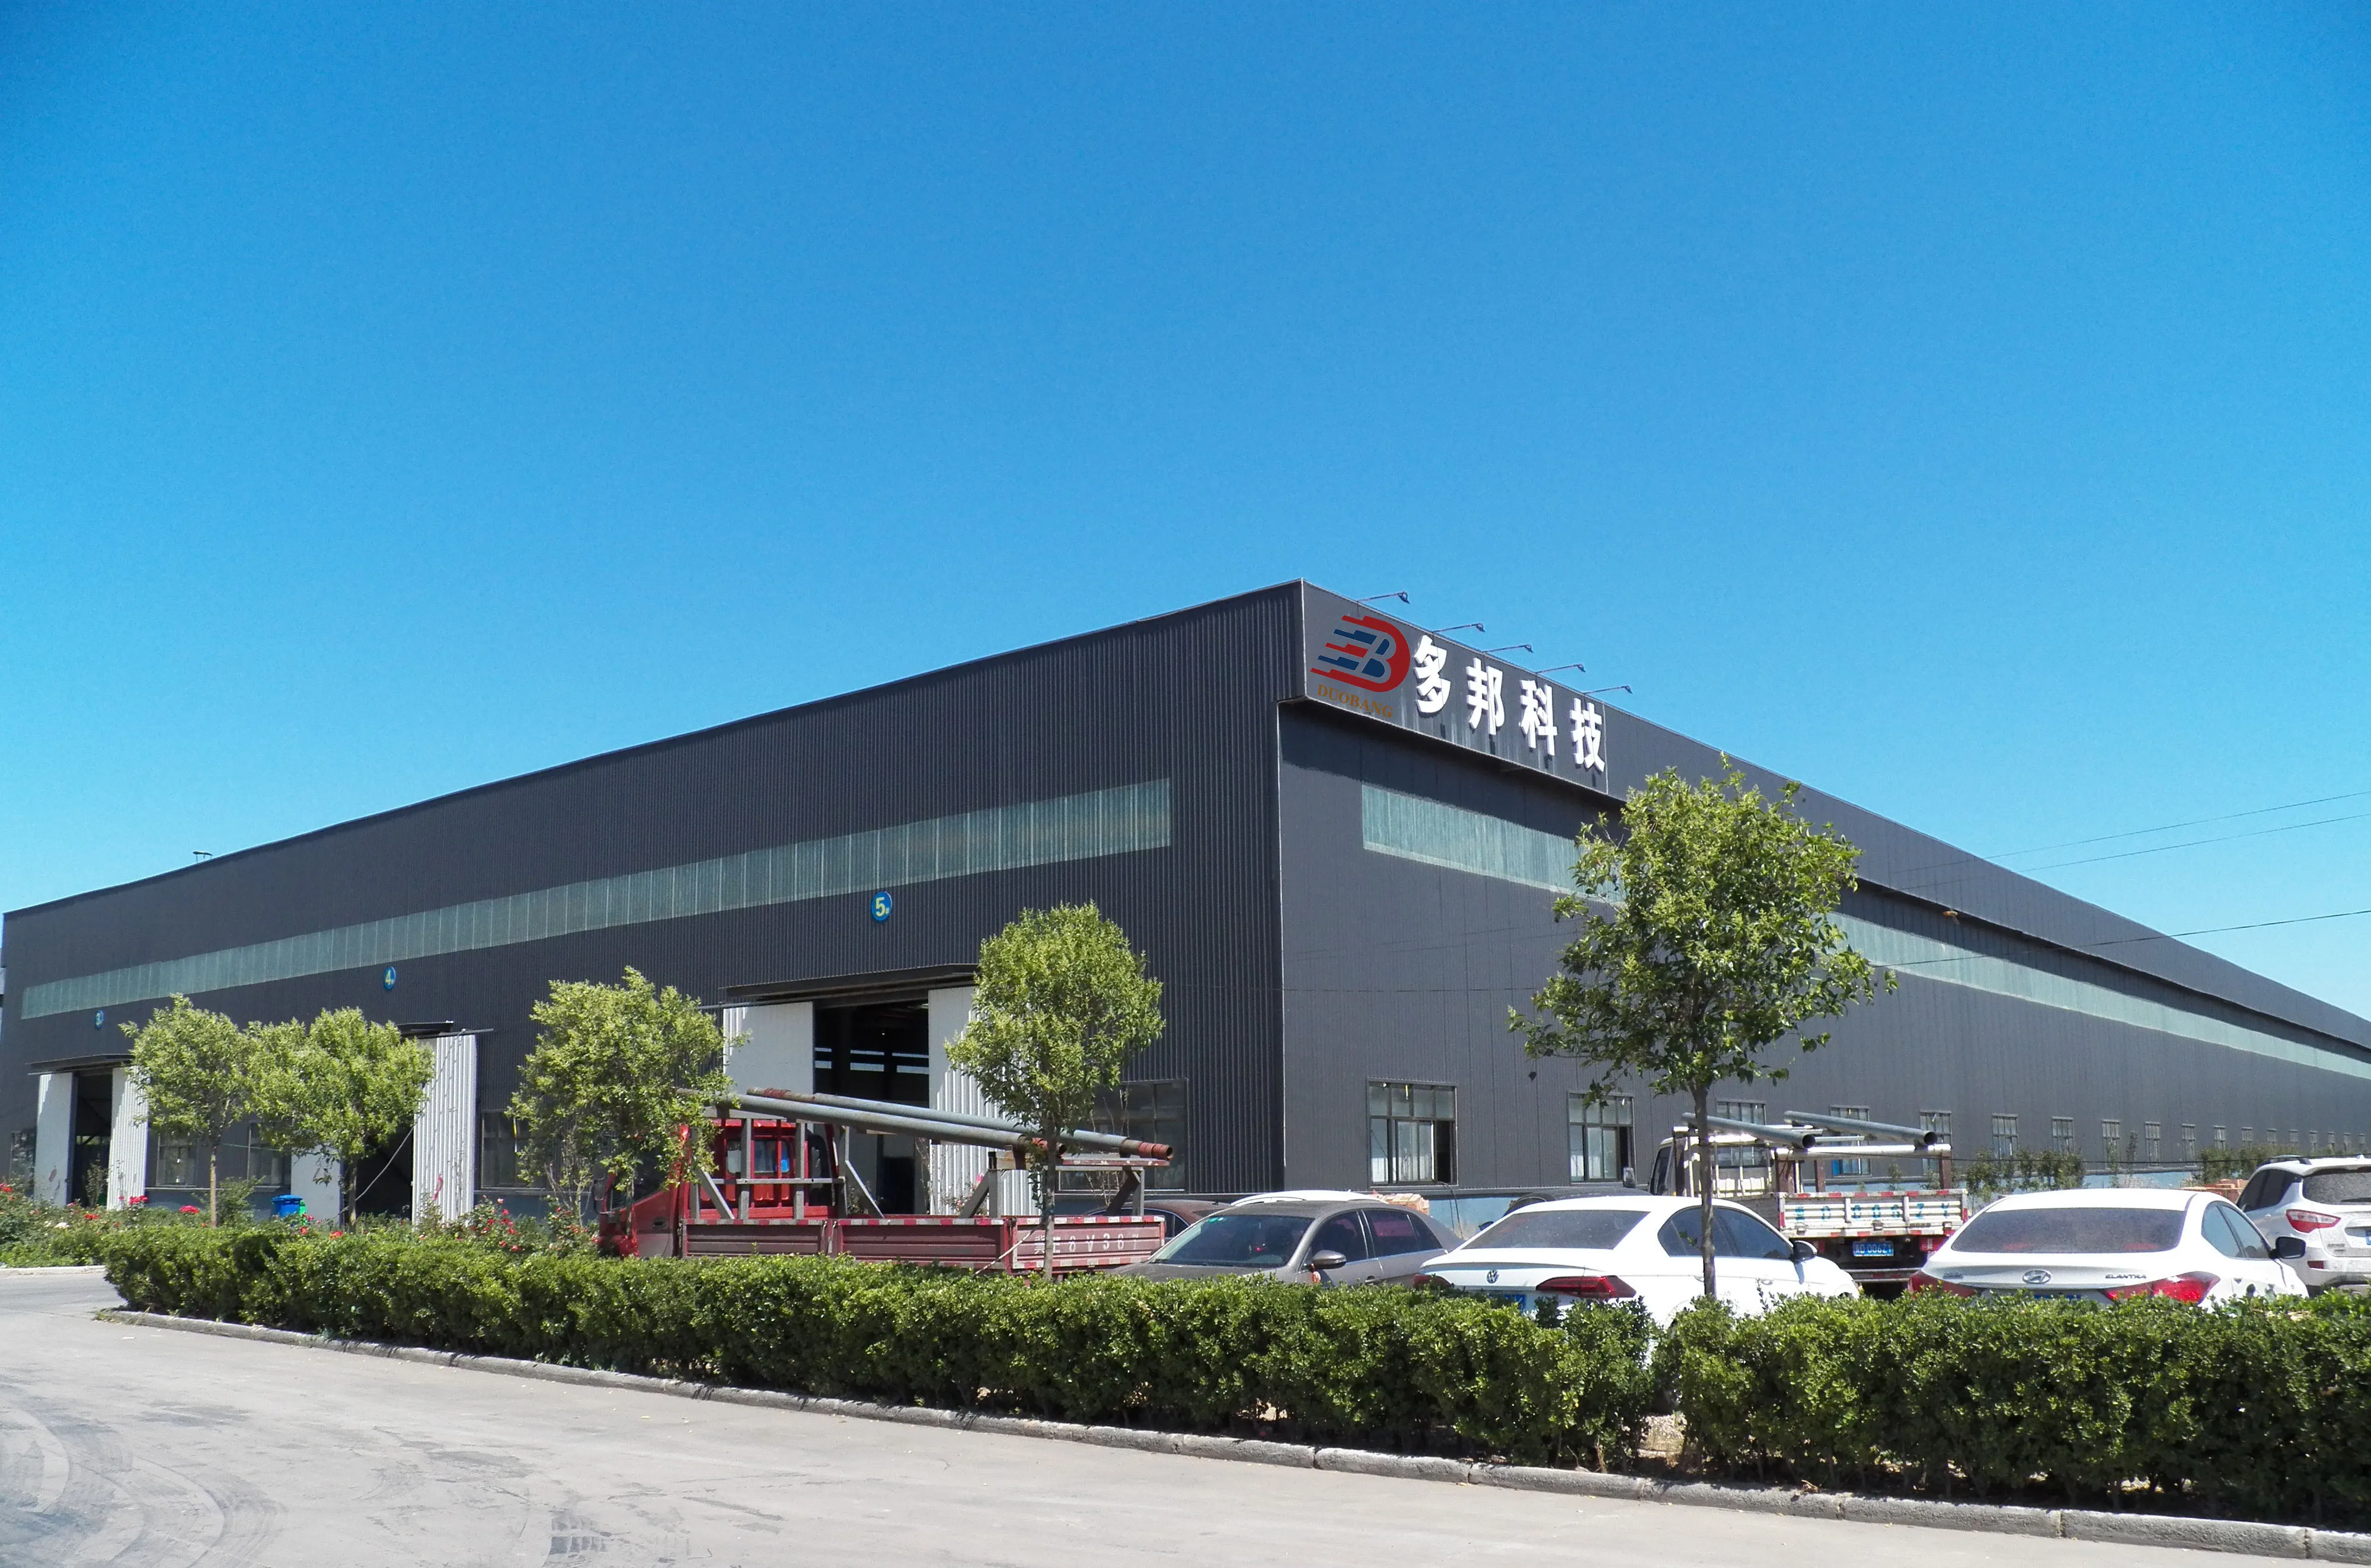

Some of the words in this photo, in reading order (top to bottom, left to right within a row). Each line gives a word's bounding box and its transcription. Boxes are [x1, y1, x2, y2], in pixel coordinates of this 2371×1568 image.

[1318, 684, 1393, 718] DUOBANG
[1413, 635, 1605, 772] 多邦科技
